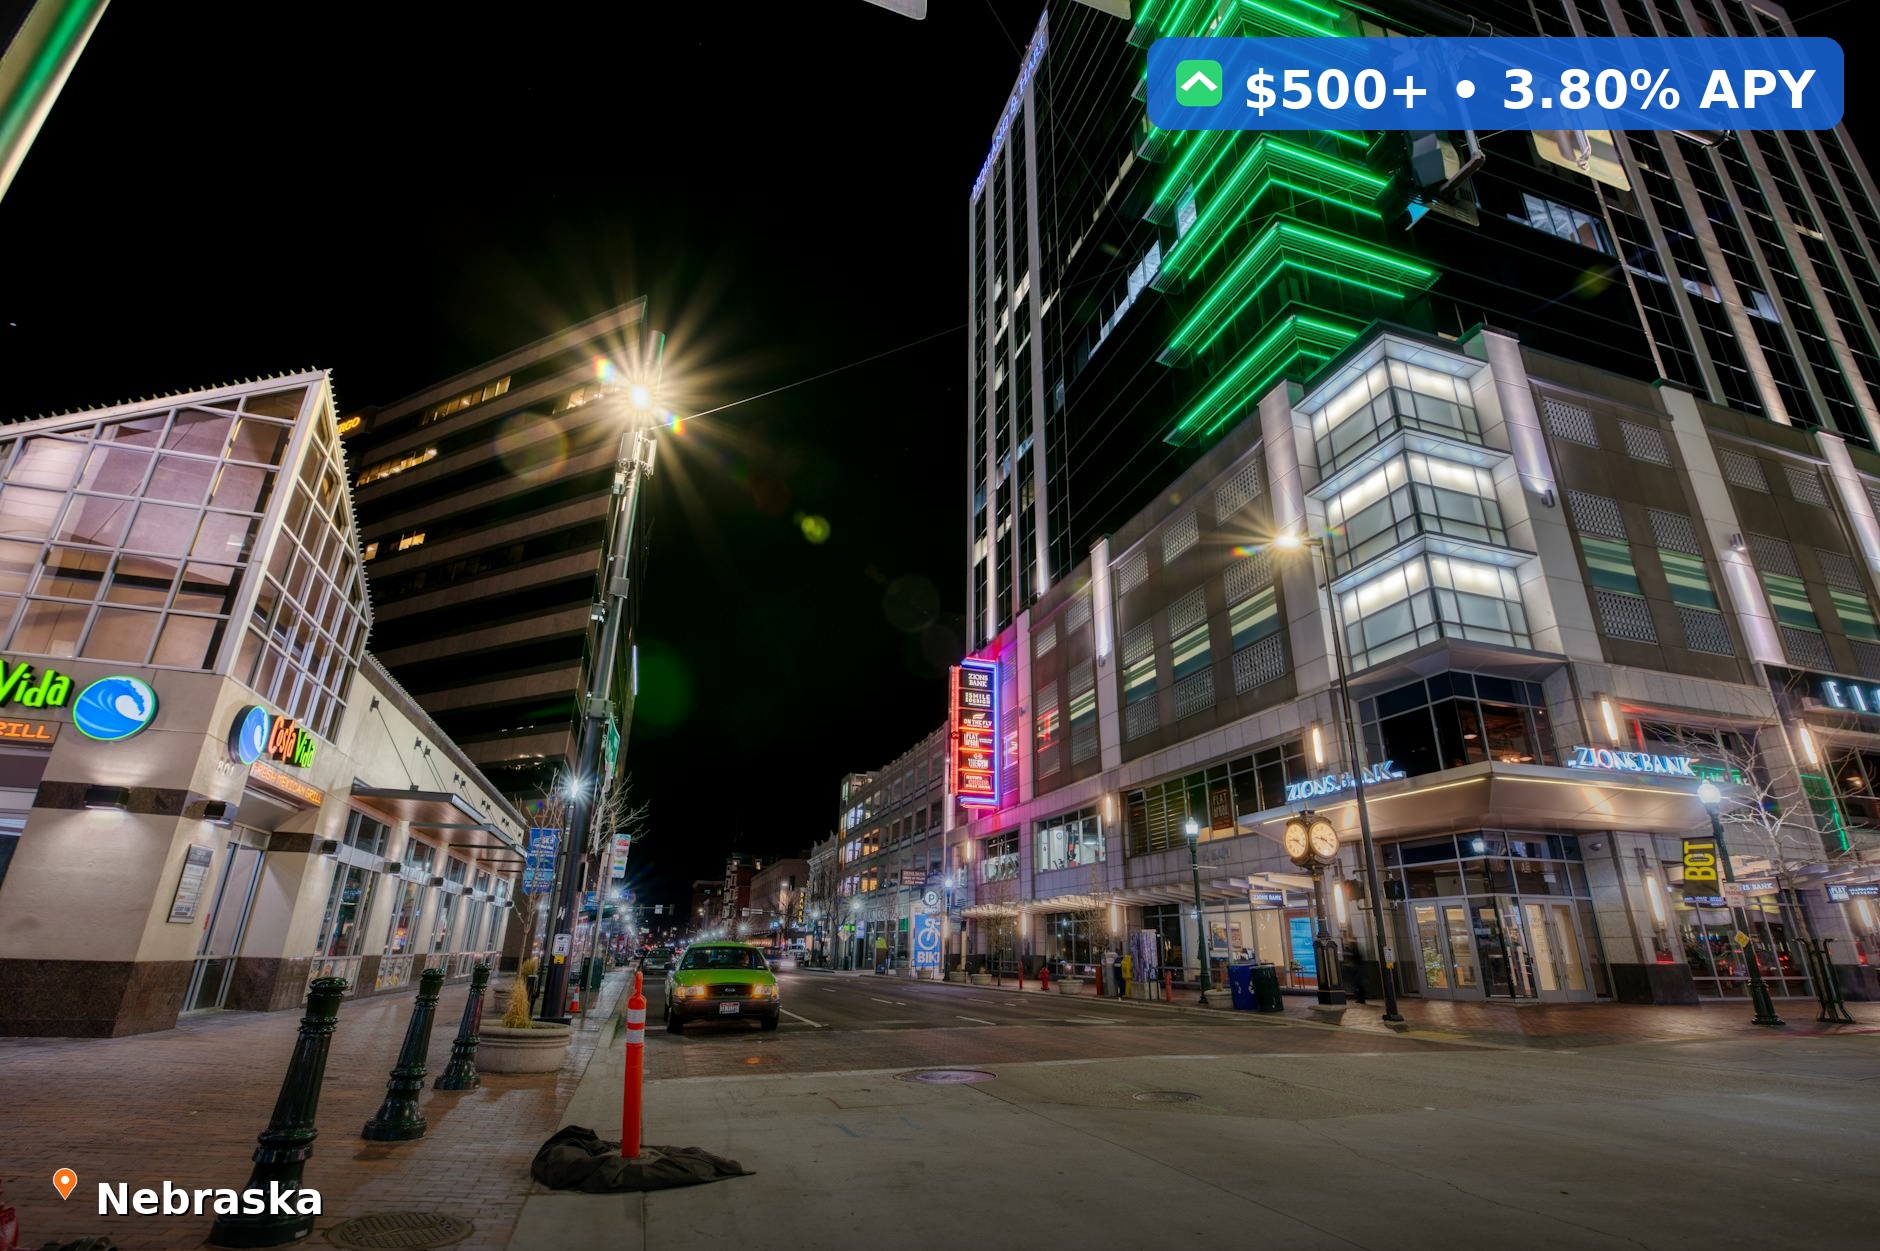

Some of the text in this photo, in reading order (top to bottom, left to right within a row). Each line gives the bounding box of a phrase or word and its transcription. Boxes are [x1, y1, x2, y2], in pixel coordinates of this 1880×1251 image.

[268, 714, 316, 768] Costa Vida
[1573, 746, 1696, 777] ZIONS BANK
[1285, 774, 1338, 801] ZIONS
[1684, 840, 1717, 880] BOT
[1752, 882, 1773, 890] BANK
